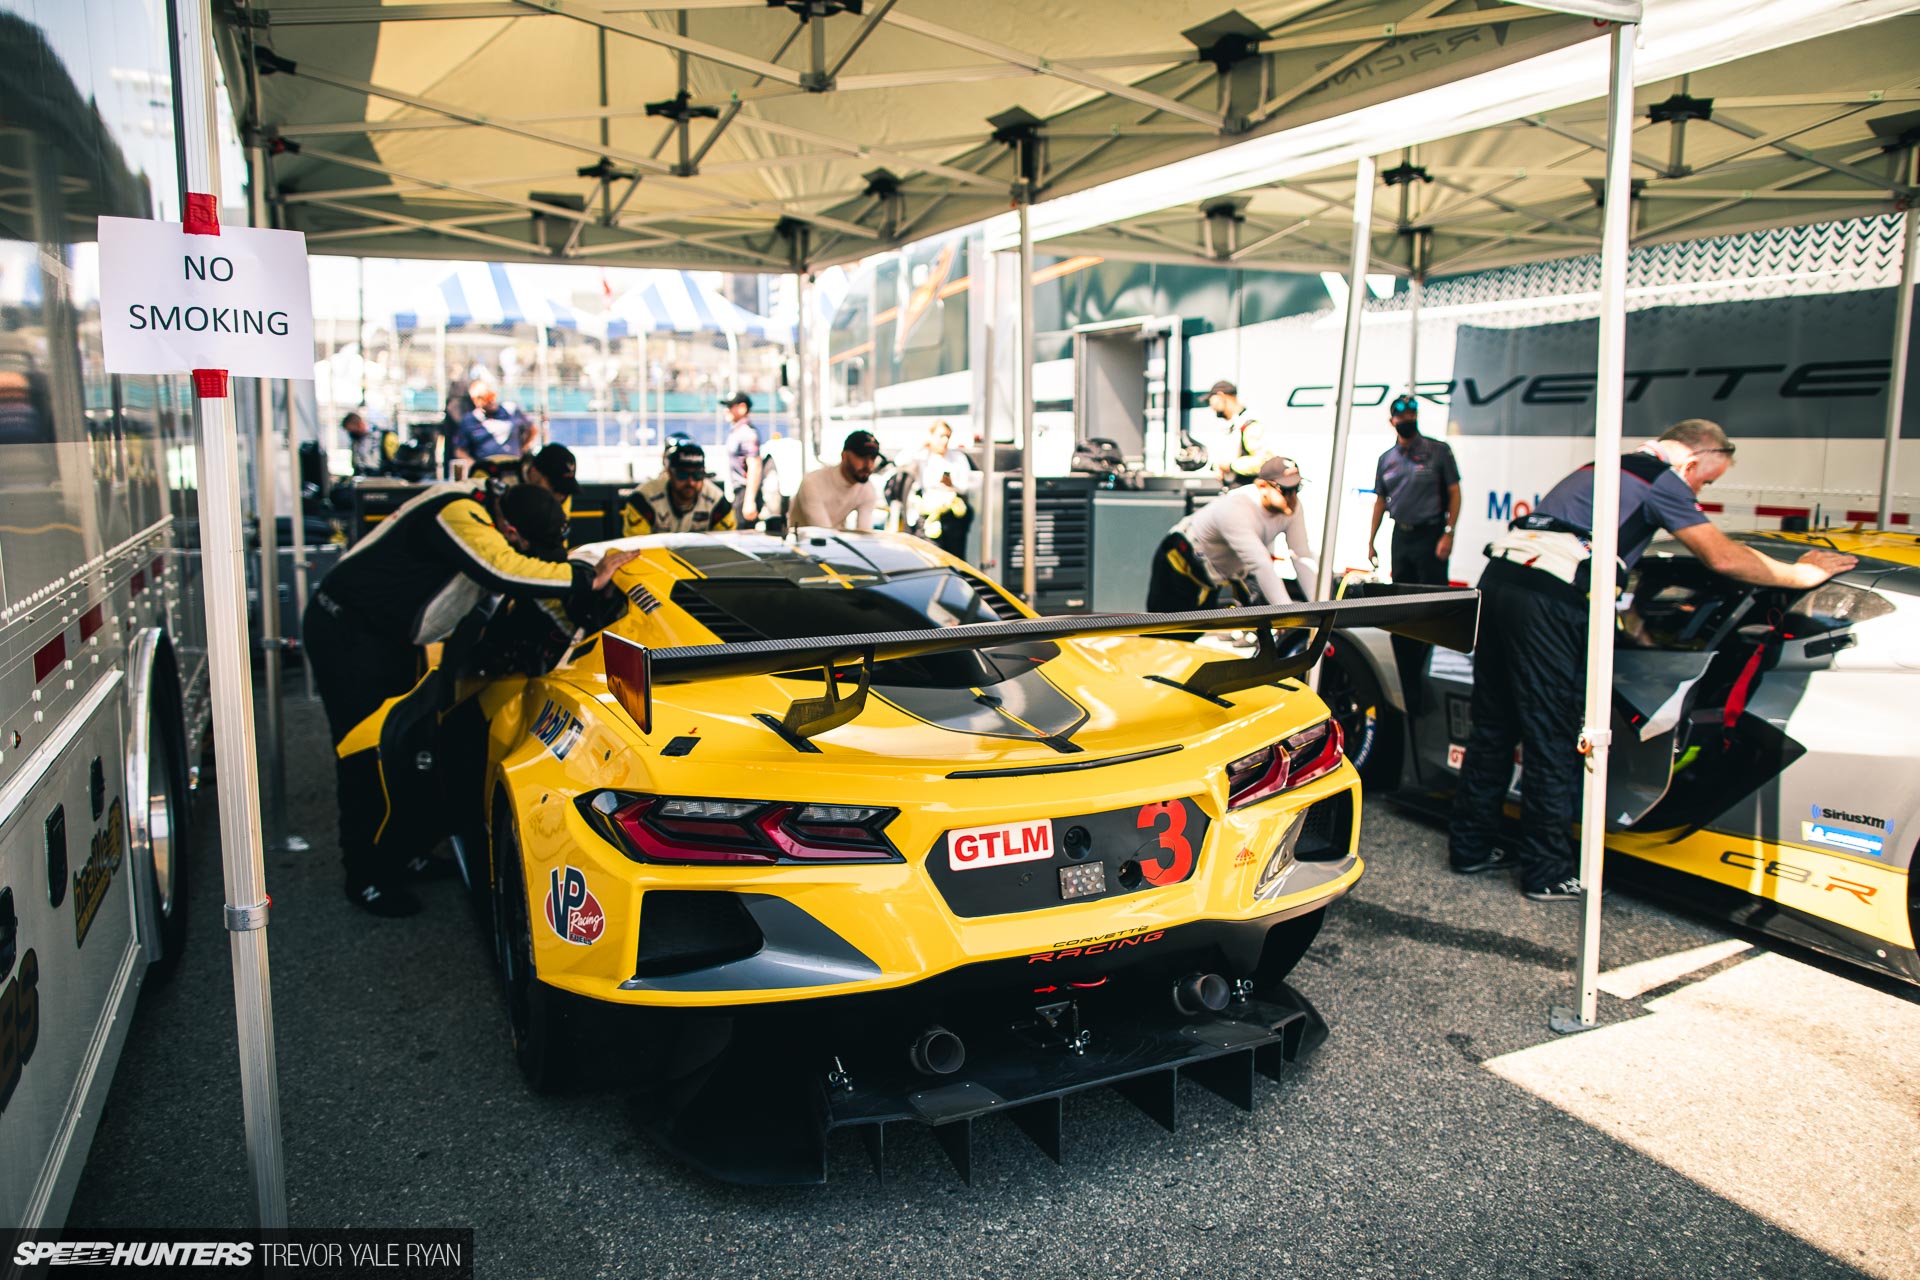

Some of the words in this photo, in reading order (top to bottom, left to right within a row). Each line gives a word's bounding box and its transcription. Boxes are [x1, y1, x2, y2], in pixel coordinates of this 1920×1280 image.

[184, 255, 234, 282] NO
[129, 304, 289, 336] SMOKING
[1286, 359, 1893, 408] CORVETTE
[954, 825, 1049, 862] GTLM
[1136, 798, 1193, 887] 3
[550, 866, 586, 941] VP
[570, 911, 604, 934] Racing
[1052, 924, 1150, 948] CORVETTE
[1027, 930, 1166, 964] RACING
